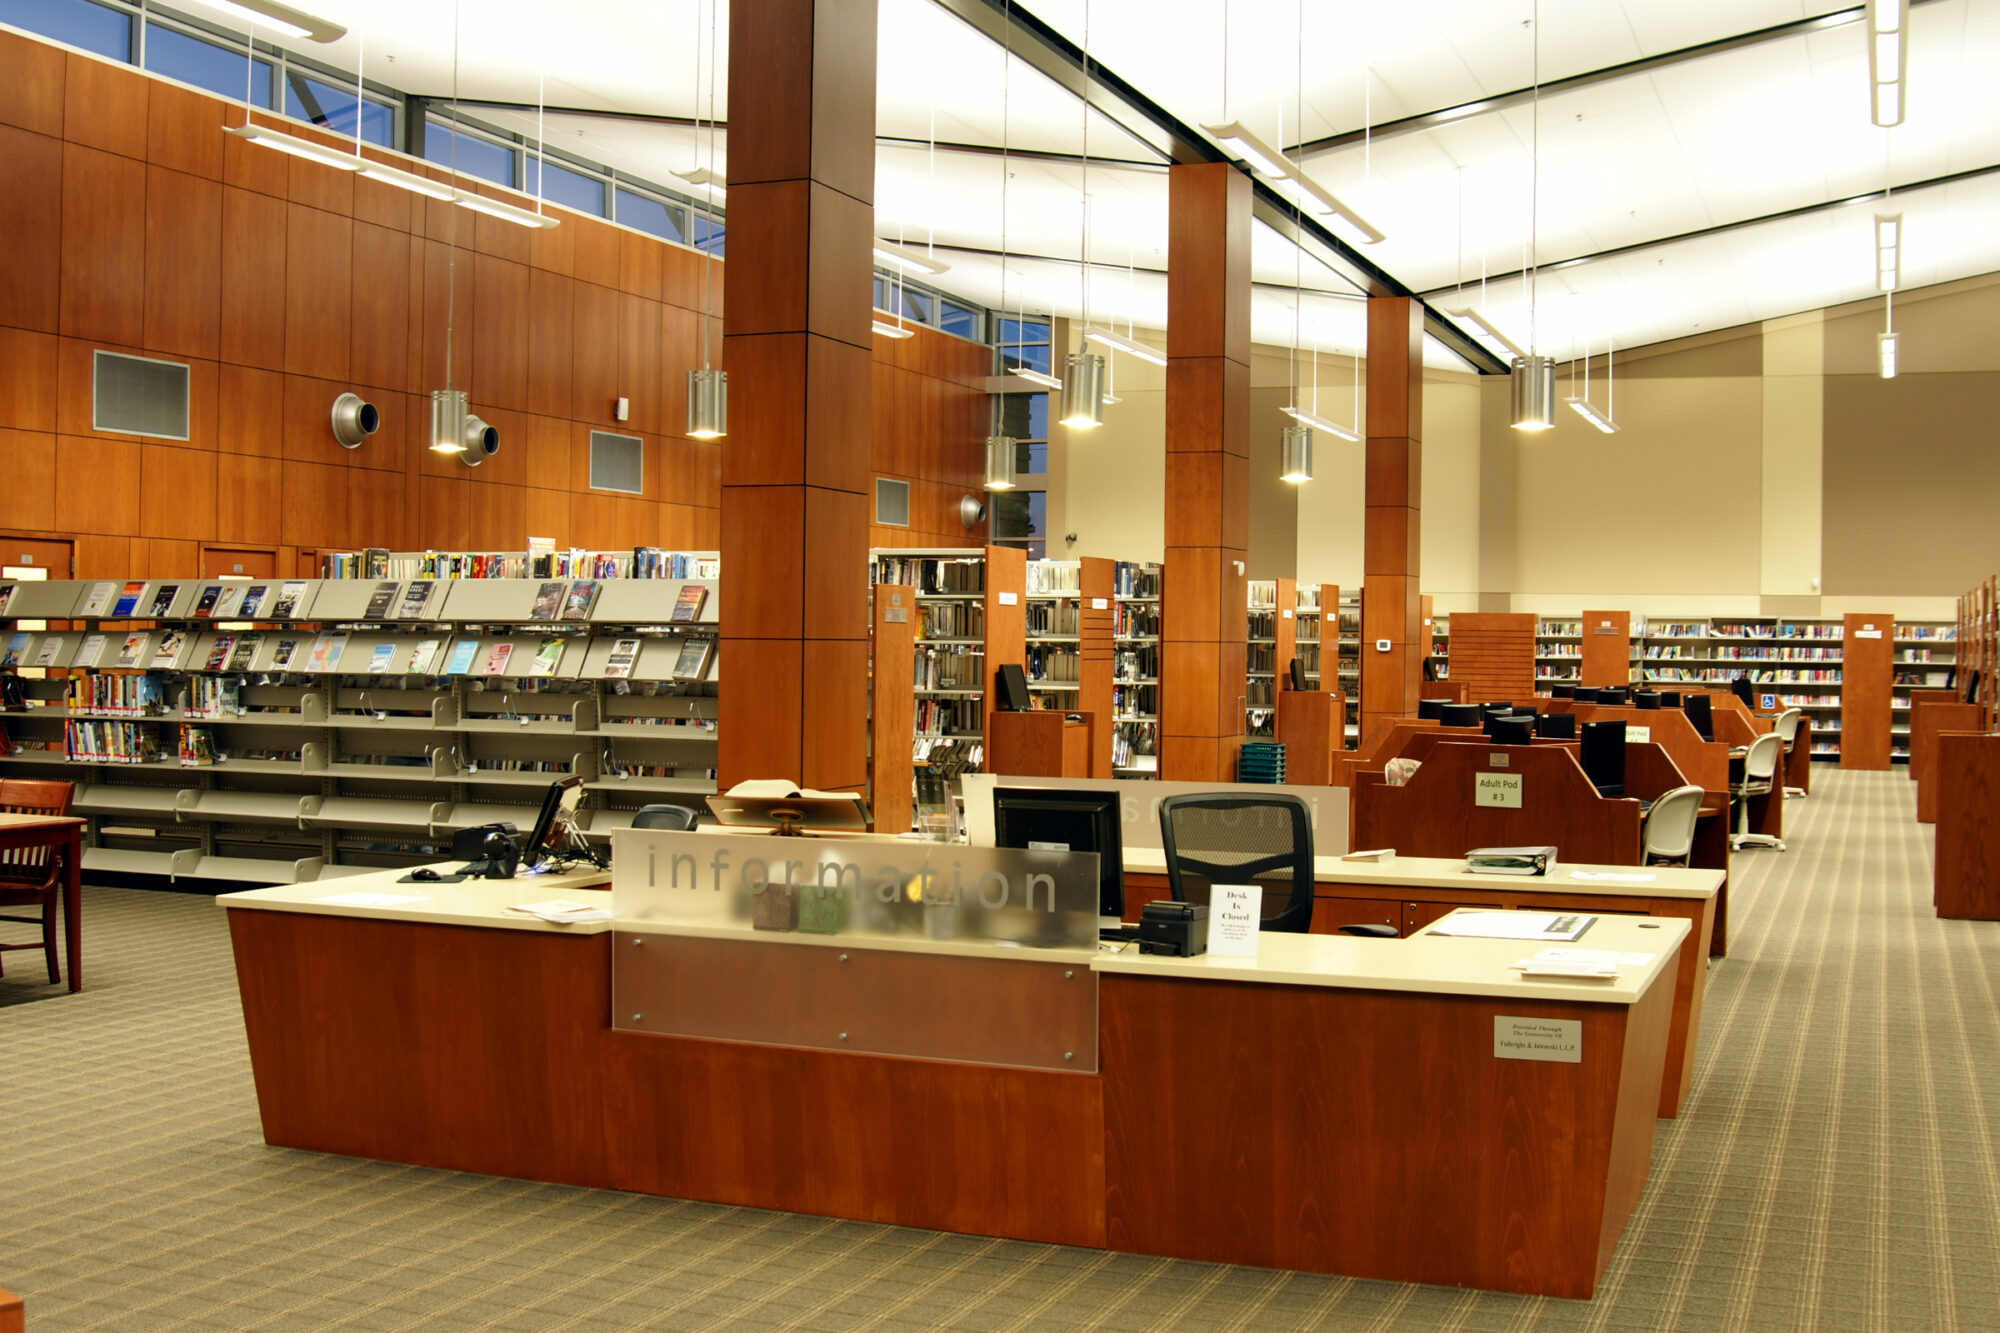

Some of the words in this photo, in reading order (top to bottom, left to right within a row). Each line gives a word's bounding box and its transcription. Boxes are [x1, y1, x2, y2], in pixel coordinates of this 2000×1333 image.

[1480, 779, 1501, 788] Adult
[1503, 780, 1518, 789] Pod
[1492, 793, 1498, 801] #
[1499, 793, 1505, 802] 3
[648, 844, 1056, 913] information
[1227, 891, 1248, 900] Desk
[1232, 902, 1241, 910] Is
[1222, 912, 1250, 921] Closed
[1500, 1040, 1526, 1049] Fulbright
[1533, 1042, 1558, 1050] Jaworski
